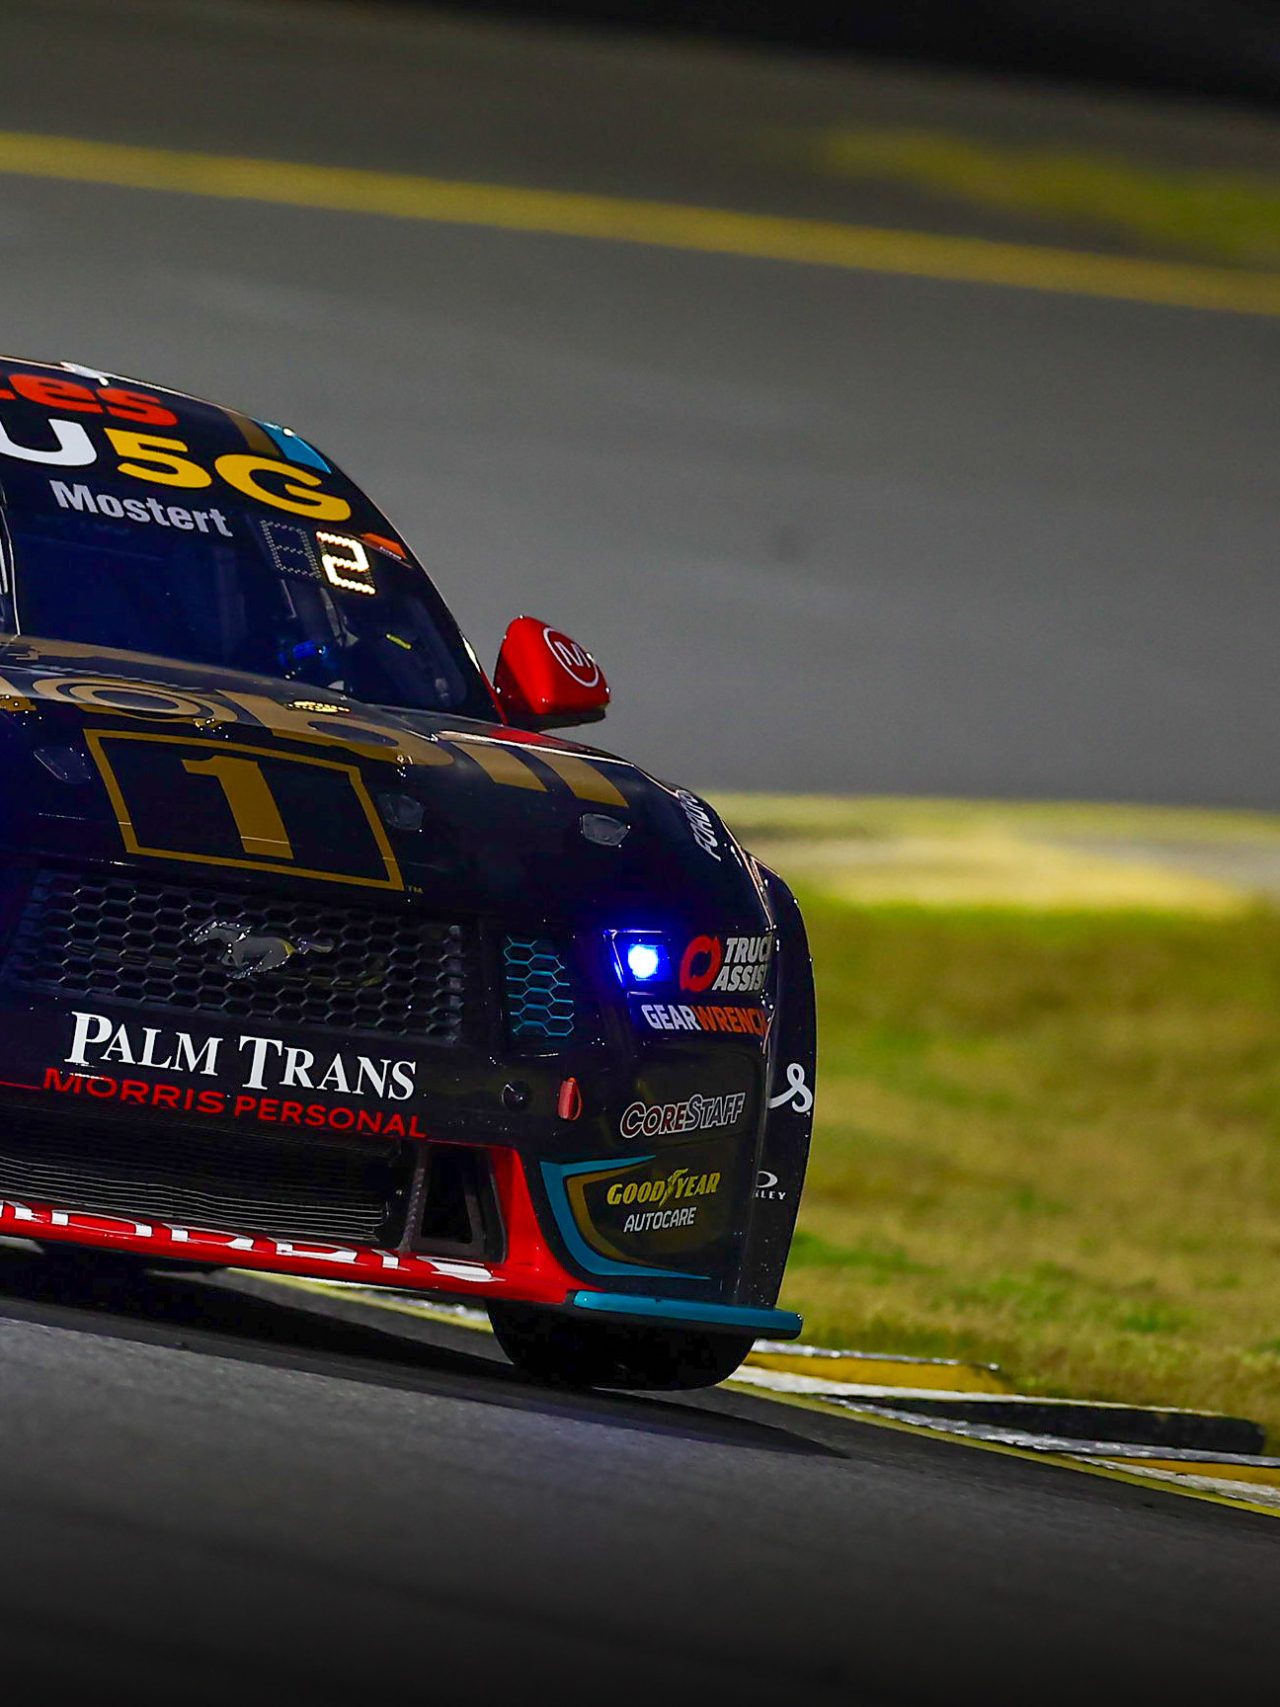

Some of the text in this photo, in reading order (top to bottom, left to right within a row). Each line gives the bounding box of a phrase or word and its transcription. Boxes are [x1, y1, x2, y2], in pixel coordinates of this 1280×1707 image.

[49, 480, 233, 537] Mostert
[316, 530, 376, 595] 2
[183, 753, 293, 860] 1
[724, 935, 773, 963] TRUC
[63, 1011, 417, 1101] PALM TRANS
[42, 1067, 427, 1138] MORRIS PERSONAL
[623, 1206, 698, 1233] AUTOCARE
